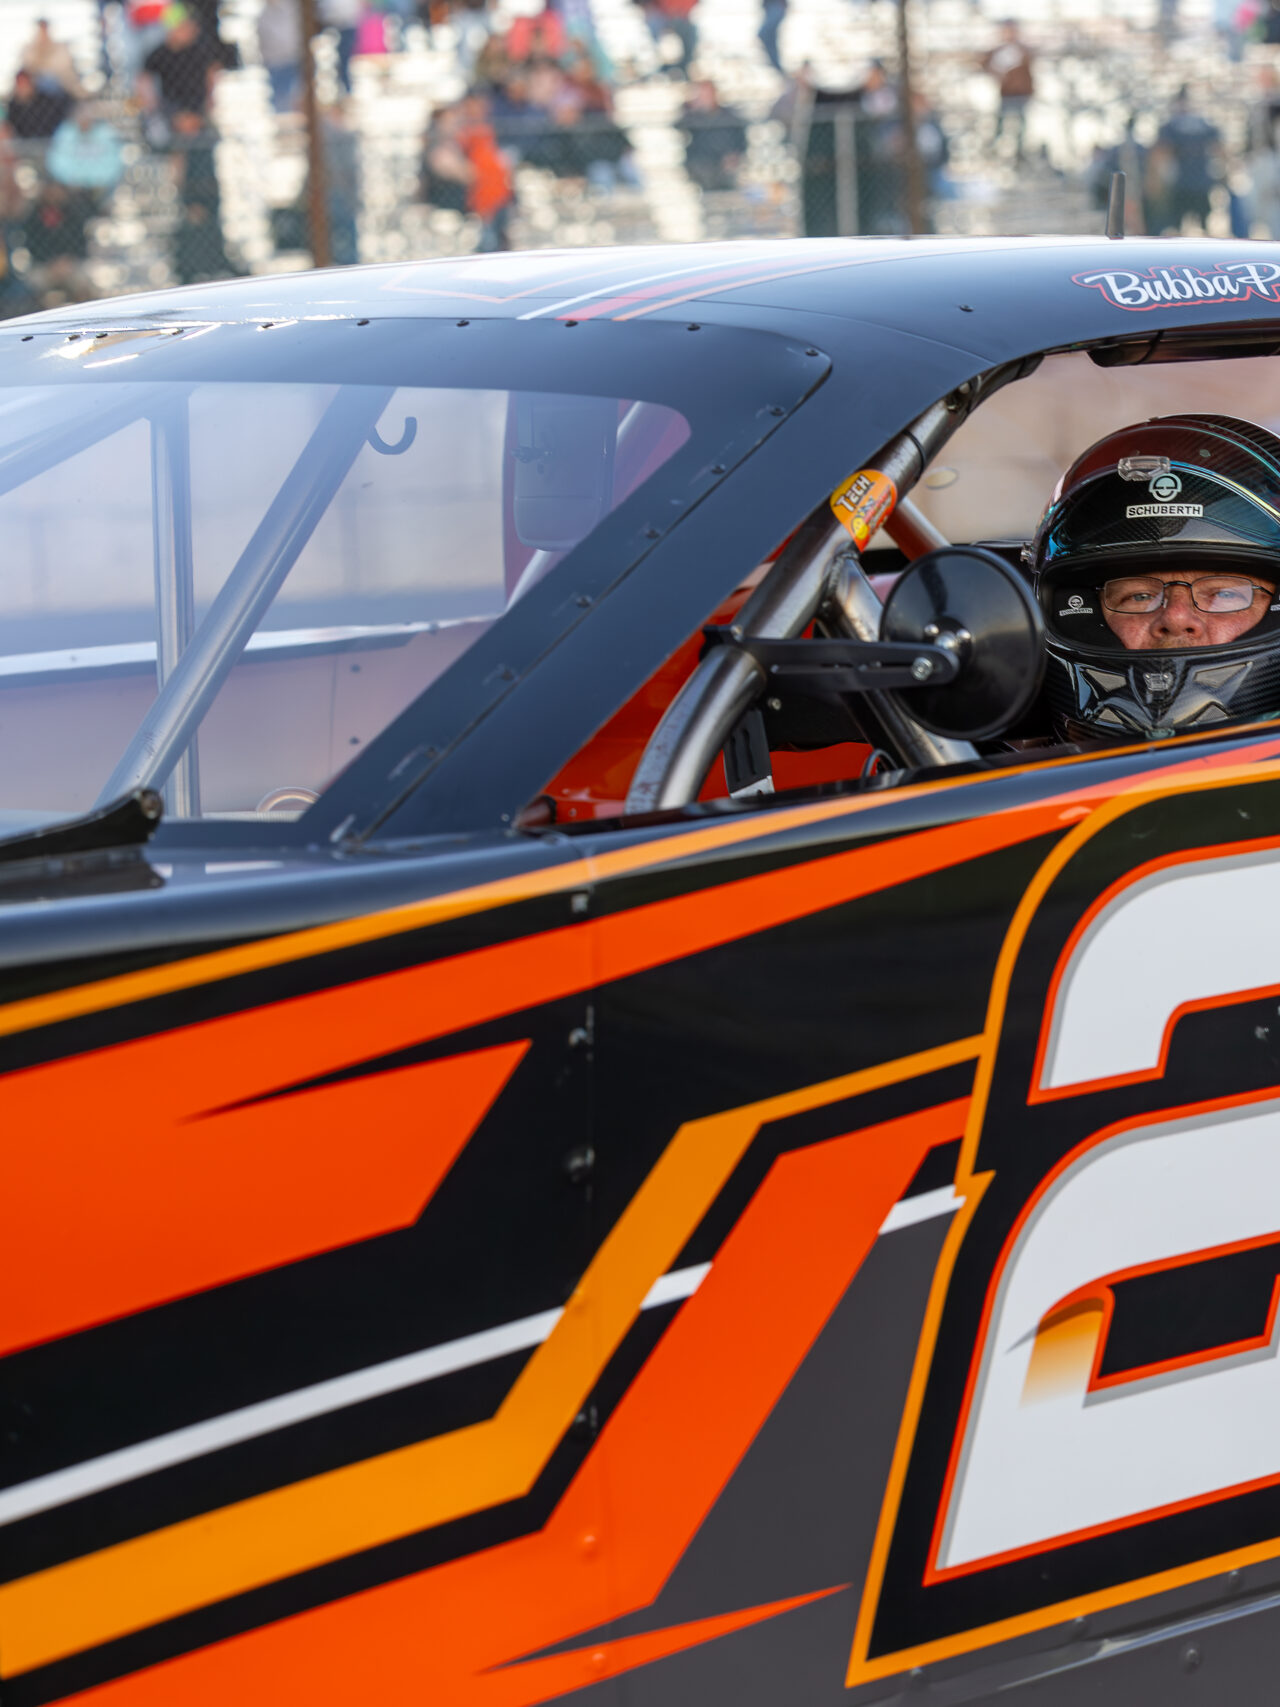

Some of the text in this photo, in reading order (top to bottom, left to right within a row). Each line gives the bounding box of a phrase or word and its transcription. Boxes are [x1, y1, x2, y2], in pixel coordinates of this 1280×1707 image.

[1083, 268, 1240, 305] Bubba
[834, 474, 873, 513] TECH
[1127, 505, 1201, 517] SCHUBERTH
